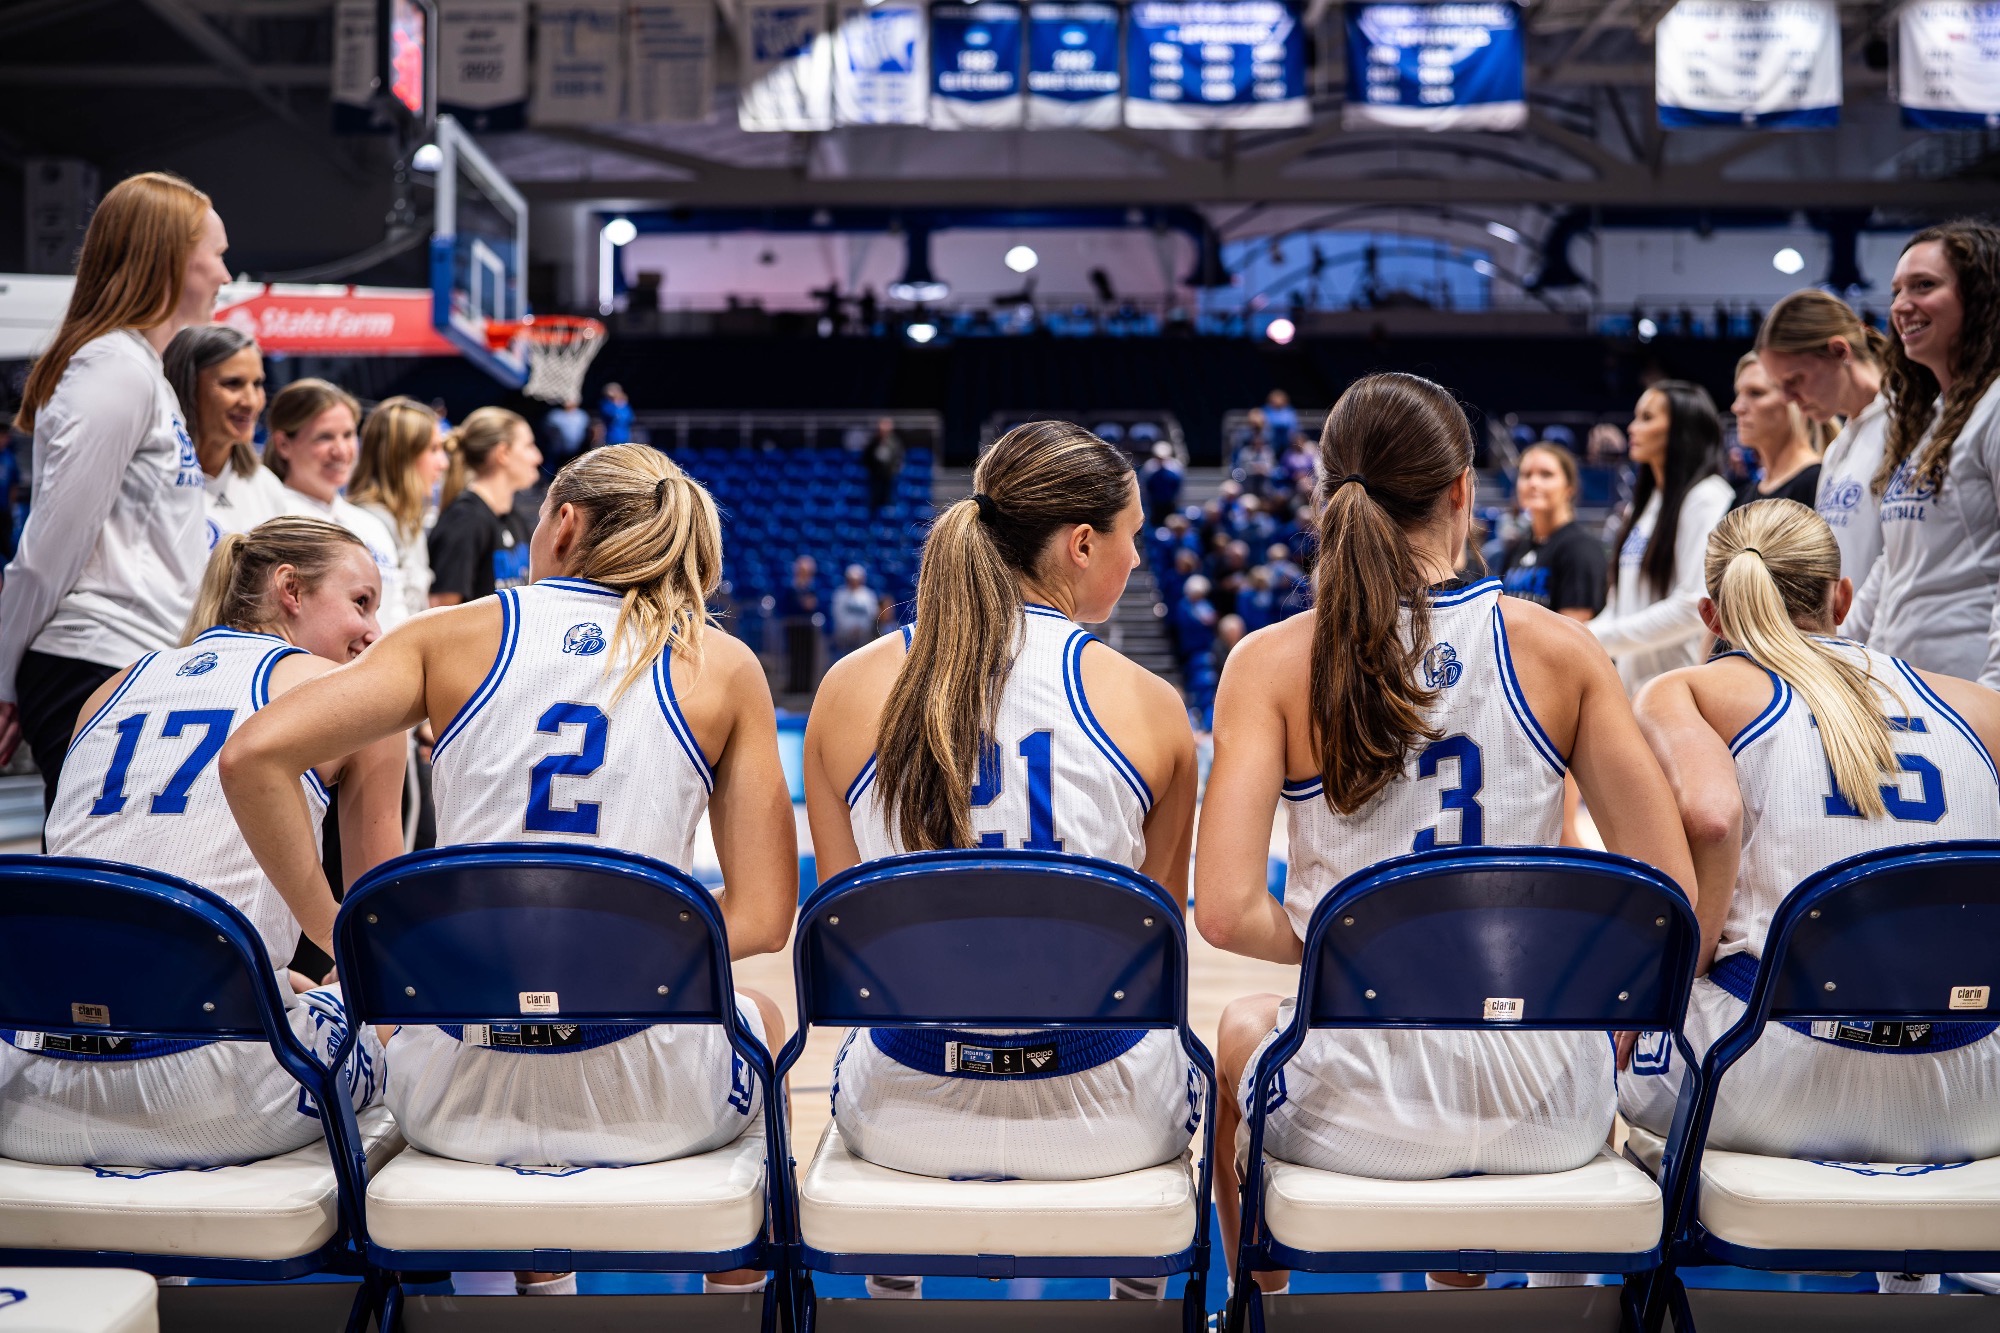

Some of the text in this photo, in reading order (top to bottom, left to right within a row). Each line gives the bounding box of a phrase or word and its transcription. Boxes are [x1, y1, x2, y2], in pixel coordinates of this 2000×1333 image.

[86, 708, 238, 818] 17
[522, 700, 612, 838] 2
[1411, 732, 1485, 853] 3
[526, 993, 551, 1004] clarin
[1957, 988, 1983, 999] clarin
[77, 1004, 102, 1016] clarin
[1491, 1000, 1516, 1011] clarin
[1905, 1023, 1931, 1032] adidas
[1003, 1054, 1010, 1064] S
[1026, 1049, 1054, 1060] adidas
